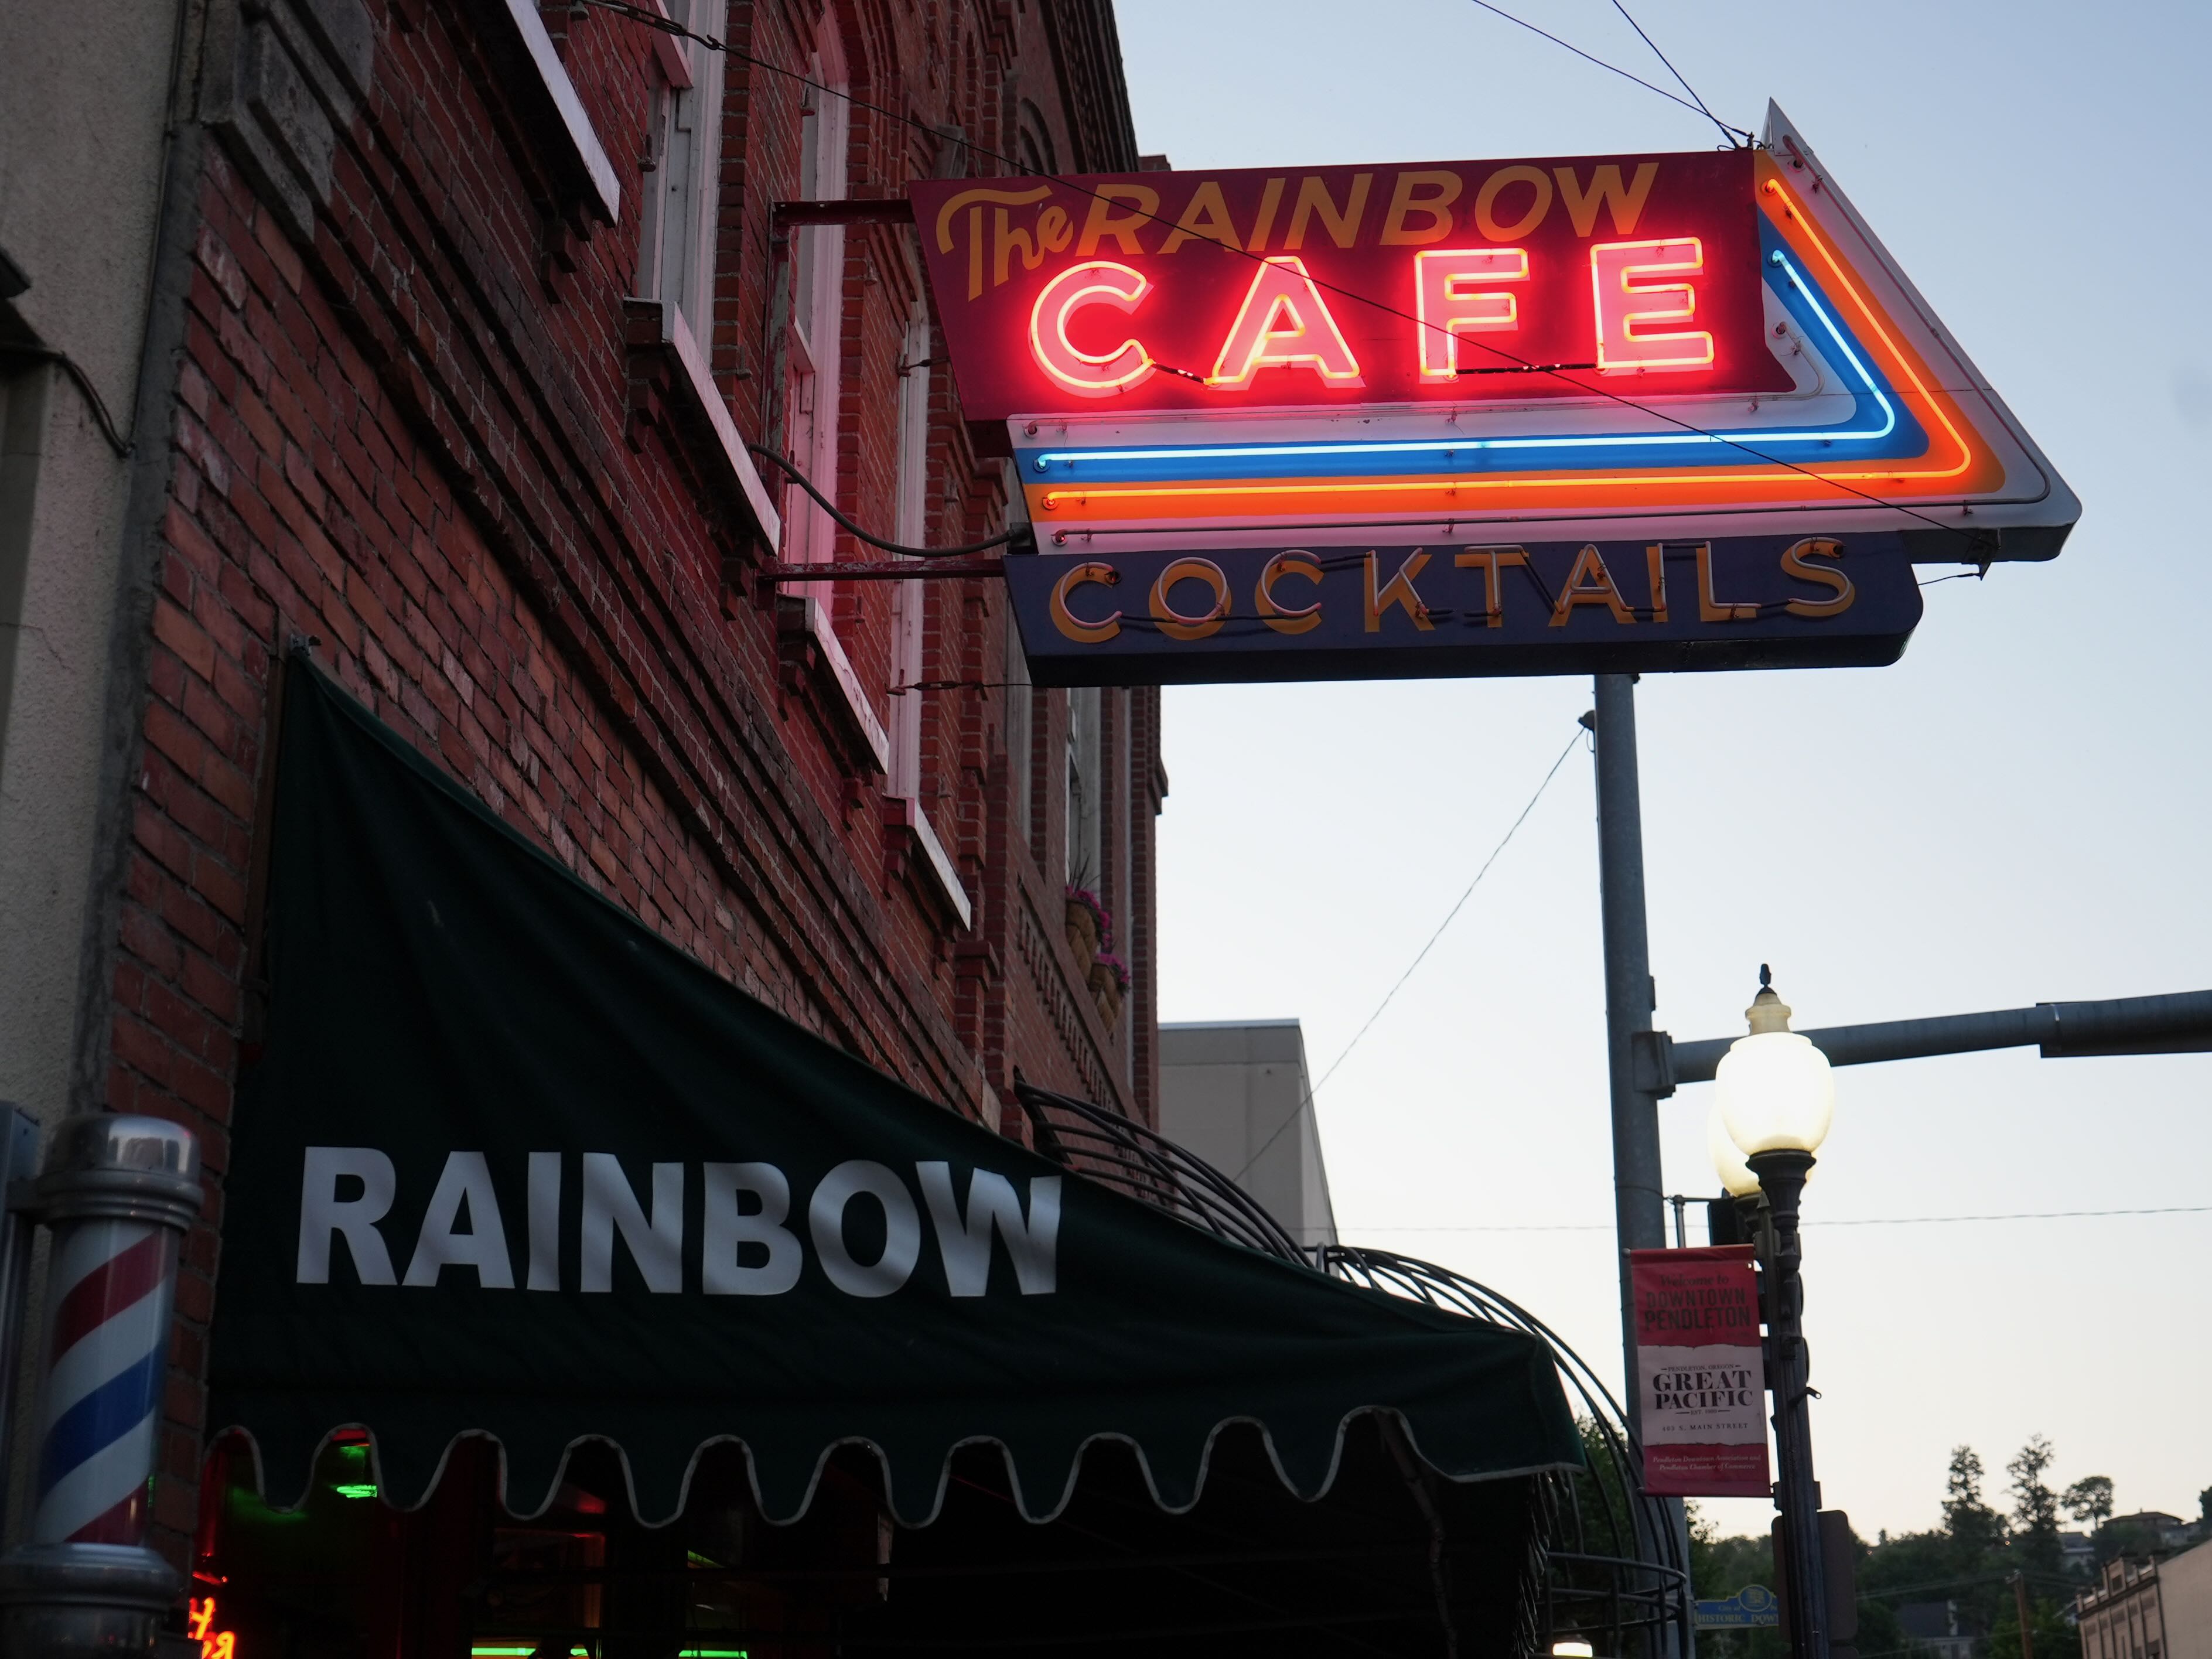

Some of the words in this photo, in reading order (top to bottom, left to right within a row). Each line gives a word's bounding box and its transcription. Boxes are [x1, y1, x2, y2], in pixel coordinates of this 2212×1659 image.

[936, 184, 1074, 303] The
[1075, 162, 1660, 257] RAINBOW
[1028, 235, 1714, 398] CAFE
[1049, 536, 1856, 644] COCKTAILS
[296, 1145, 1062, 1298] RAINBOW
[1660, 1274, 1713, 1286] Welcome
[1716, 1274, 1729, 1285] to
[1646, 1288, 1745, 1308] DOWNTOWN
[1645, 1307, 1750, 1330] PENDLETON
[1653, 1370, 1752, 1392] GREAT
[1655, 1390, 1753, 1410] PACIFIC
[1698, 1614, 1743, 1622] HISTORIC
